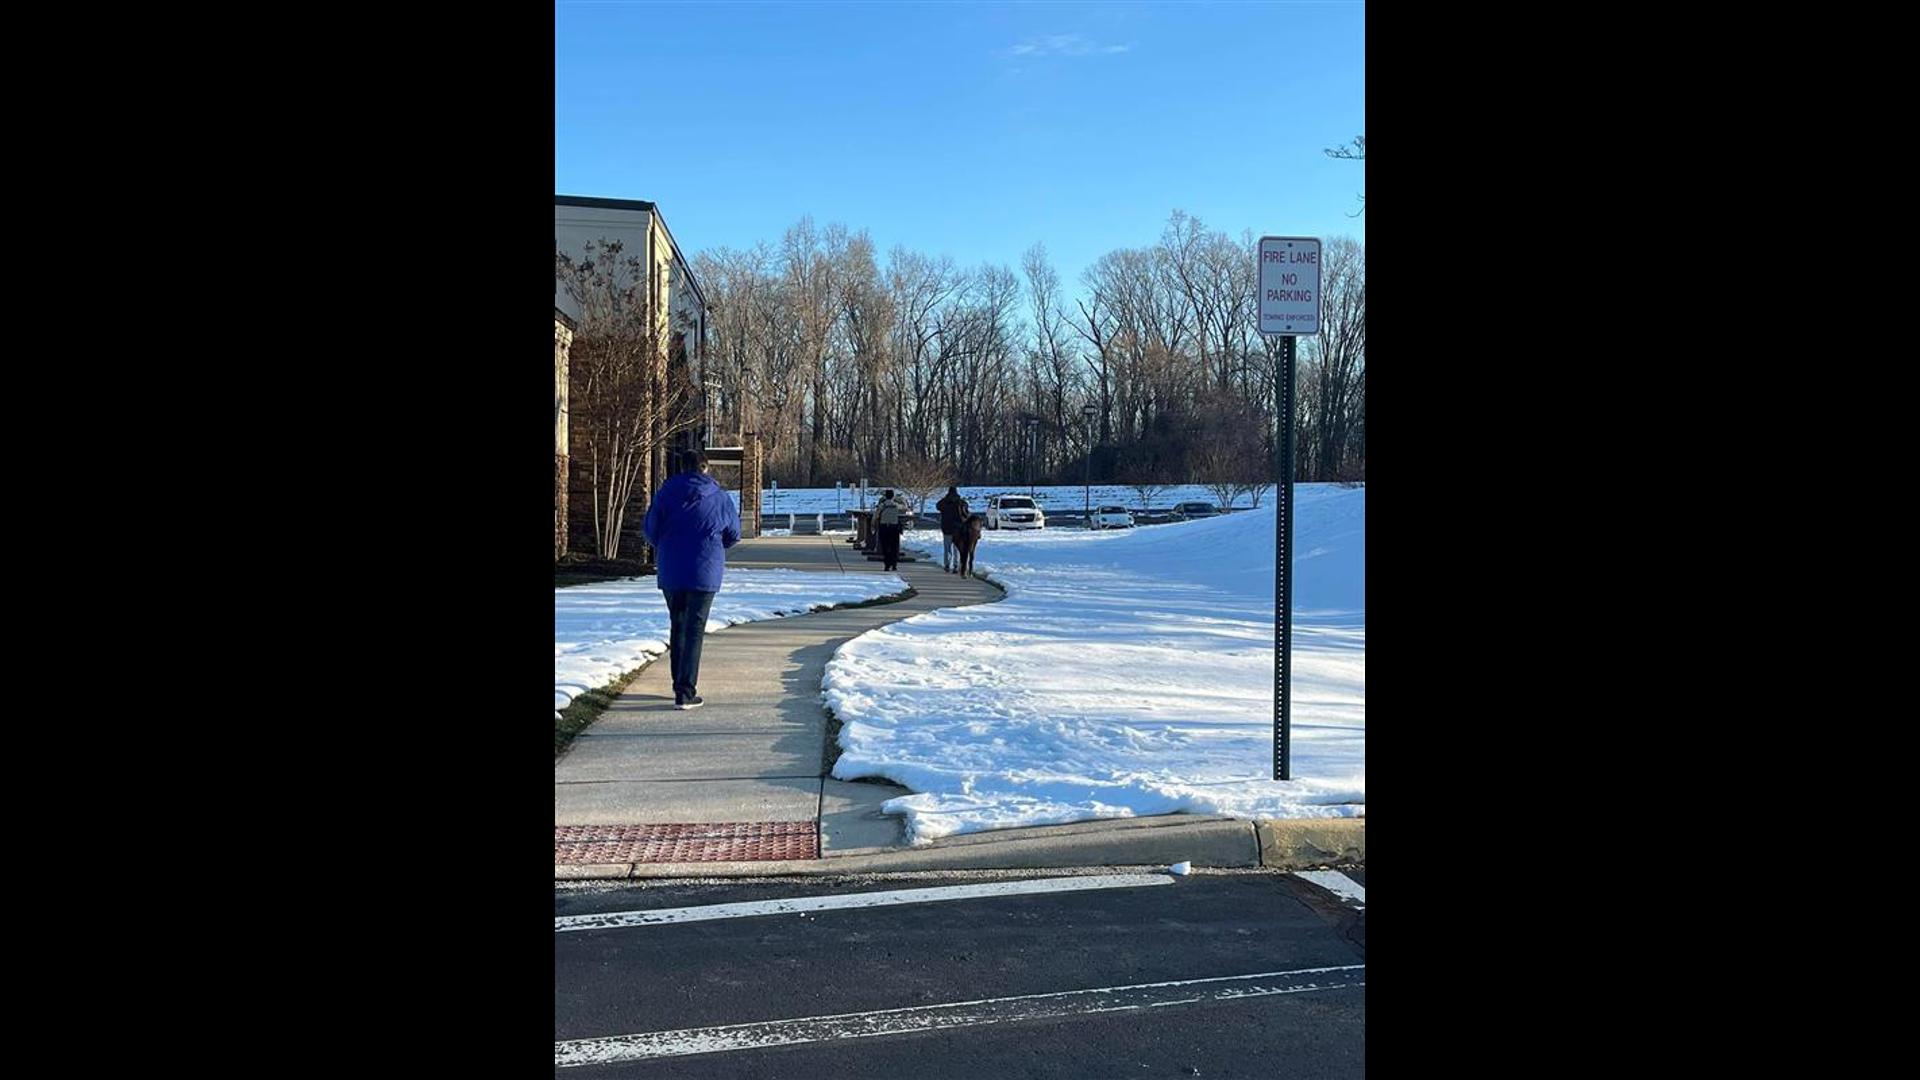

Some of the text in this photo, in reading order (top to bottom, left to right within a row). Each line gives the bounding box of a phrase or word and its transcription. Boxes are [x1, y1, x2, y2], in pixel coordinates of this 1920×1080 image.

[1263, 251, 1317, 264] FIRE LANE
[1282, 273, 1298, 285] NO
[1267, 289, 1312, 302] PARKING
